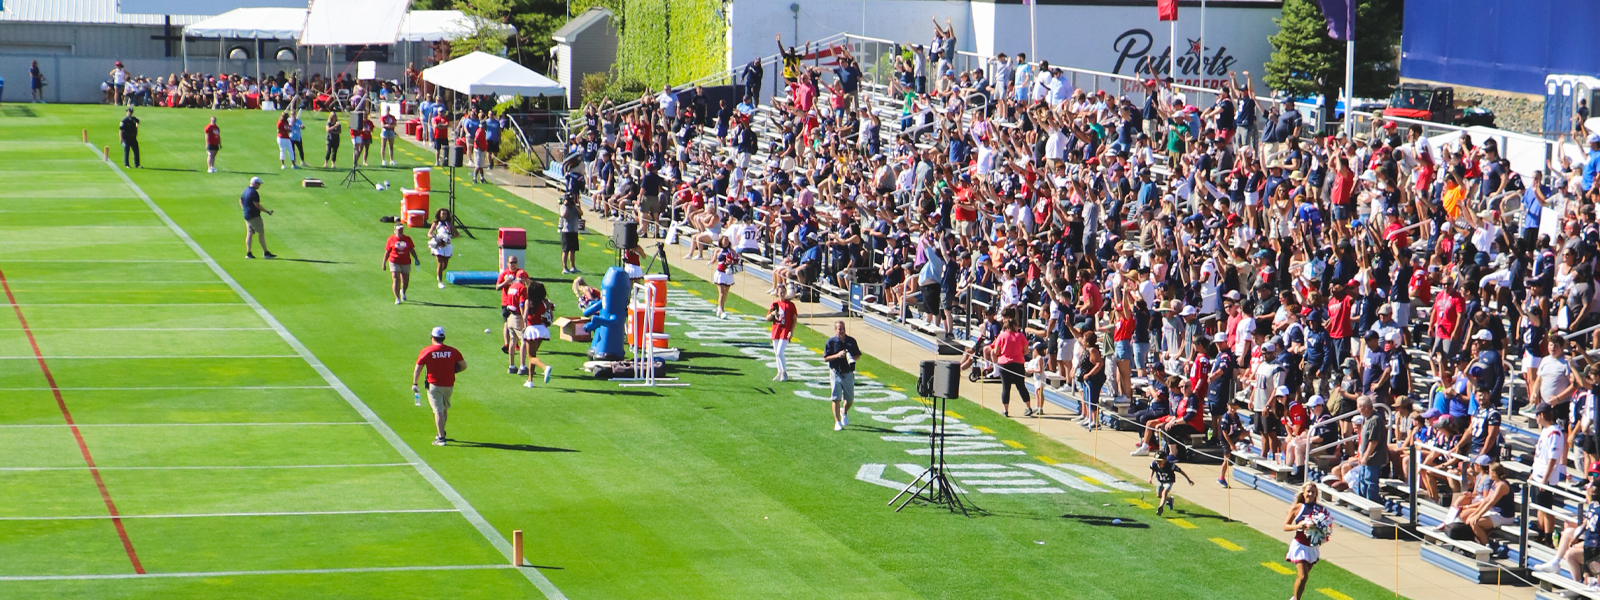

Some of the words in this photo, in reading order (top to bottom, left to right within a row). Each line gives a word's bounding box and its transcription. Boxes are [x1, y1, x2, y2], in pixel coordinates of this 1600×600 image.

[1110, 28, 1237, 81] Patriots
[1123, 79, 1228, 94] CHEADERS
[744, 230, 756, 240] 07
[431, 351, 452, 359] STAFF
[854, 405, 1027, 456] Mass
